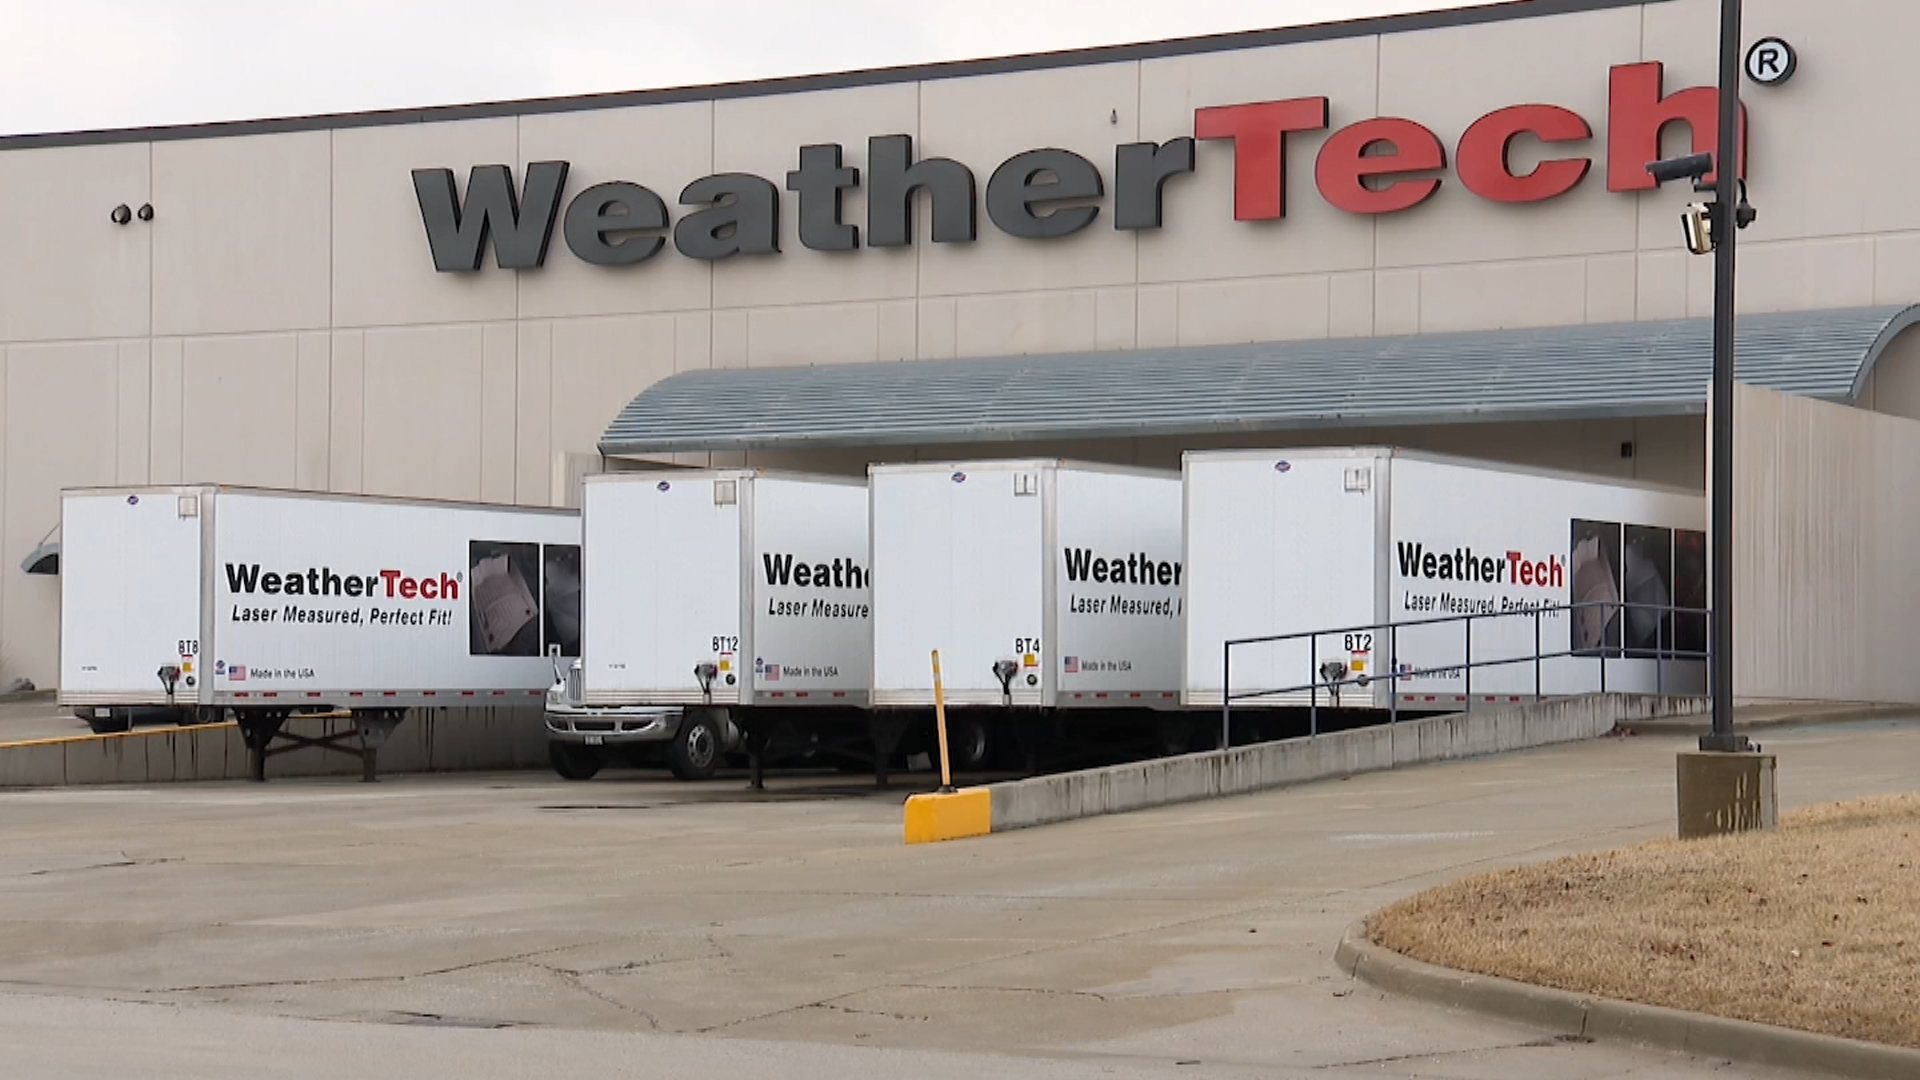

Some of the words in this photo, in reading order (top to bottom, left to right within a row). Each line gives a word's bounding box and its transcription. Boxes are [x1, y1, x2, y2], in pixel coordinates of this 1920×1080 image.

[763, 553, 869, 589] Weath
[1397, 541, 1563, 588] WeatherTech
[225, 563, 459, 600] WeatherTech
[768, 597, 807, 616] Laser
[811, 598, 869, 619] Measure
[1070, 594, 1106, 614] Laser
[1109, 595, 1173, 620] Measured,
[1405, 590, 1436, 611] Laser
[232, 604, 277, 622] Laser
[283, 605, 364, 626] Measured,
[370, 607, 424, 626] Perfect
[428, 609, 452, 626] Fit!
[178, 640, 199, 655] BT8
[712, 636, 738, 651] BT12
[1015, 637, 1040, 653] BT4
[1344, 634, 1372, 651] BT2
[250, 668, 272, 678] Made
[274, 668, 282, 678] in
[283, 668, 296, 678] the
[298, 668, 315, 679] USA
[783, 666, 802, 677] Made
[803, 666, 810, 677] in
[812, 666, 822, 677] the
[823, 666, 838, 677] USA
[1081, 660, 1099, 672] Made
[1100, 660, 1106, 671] in
[1107, 660, 1117, 671] the
[1118, 660, 1132, 671] USA
